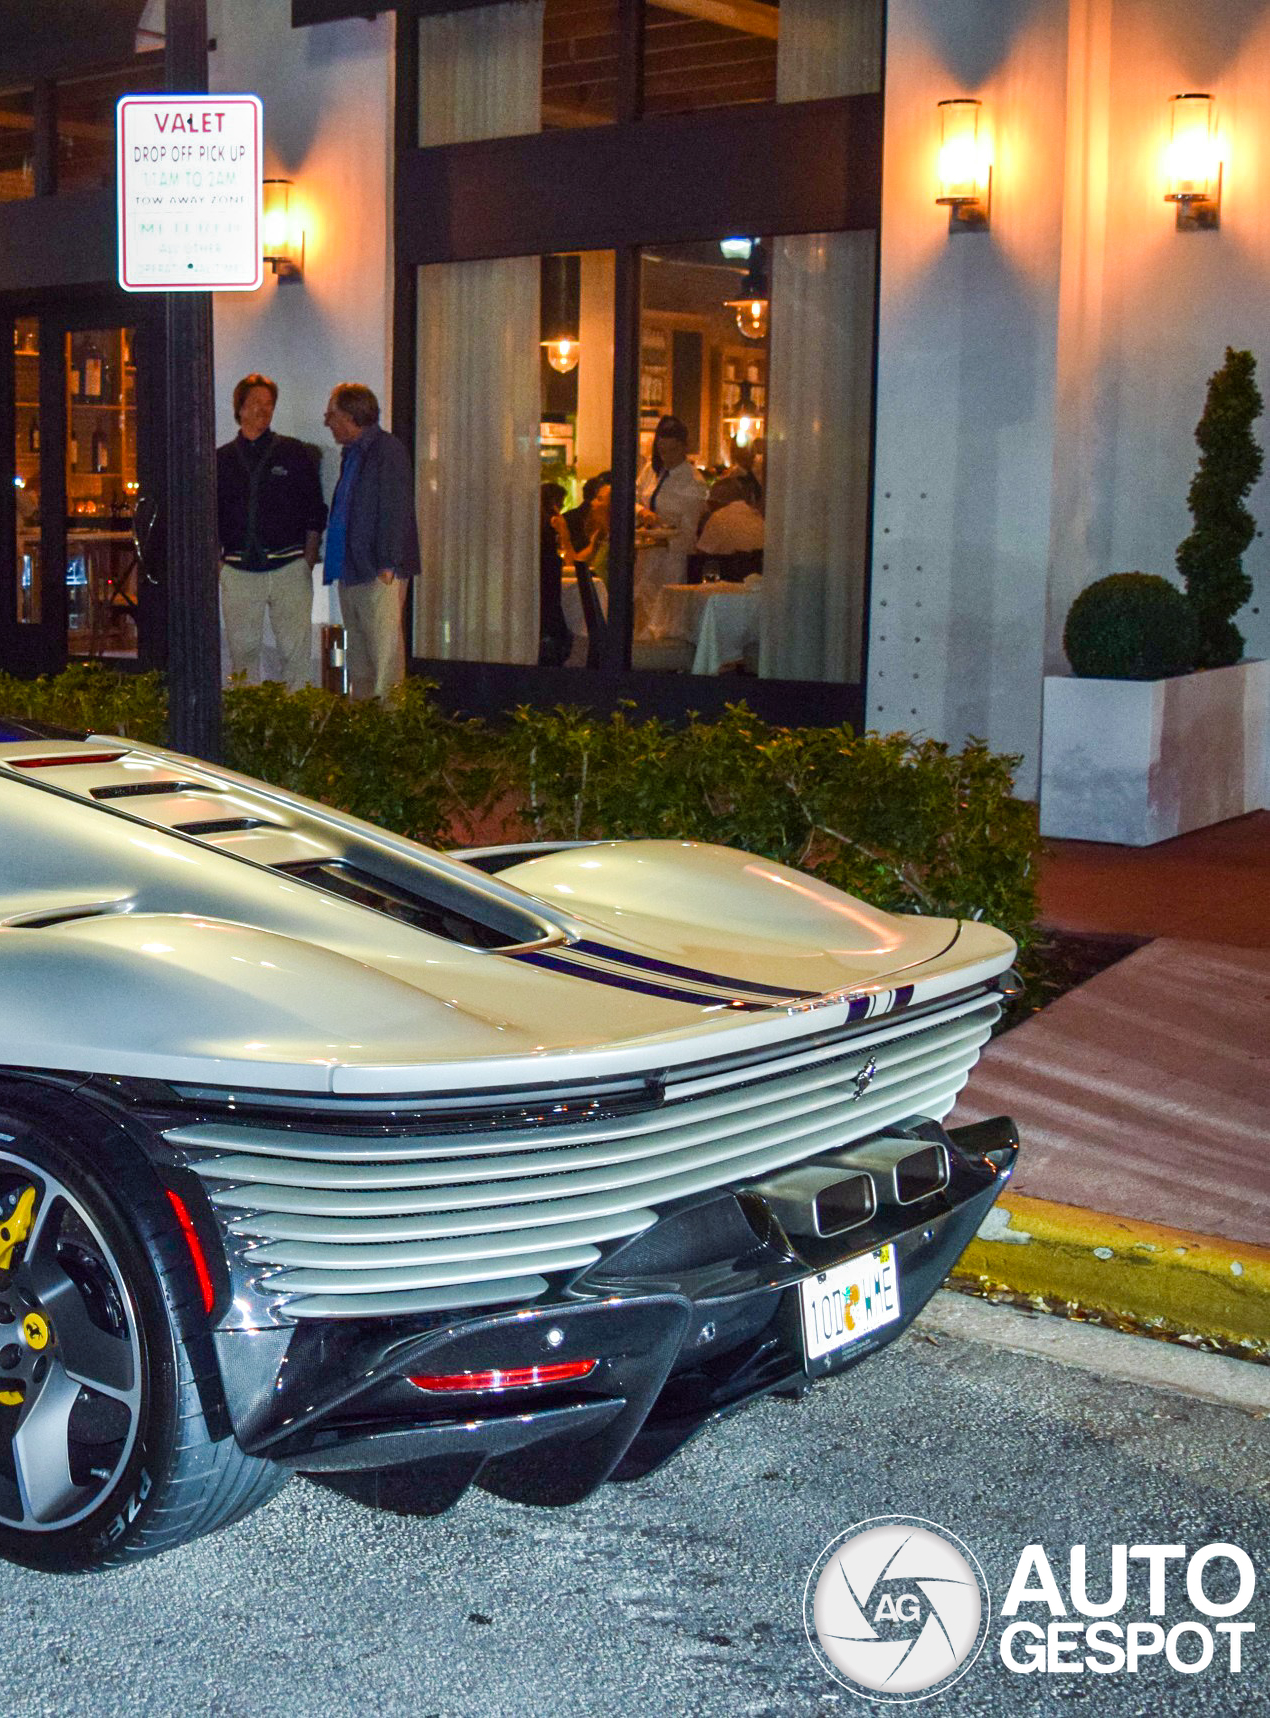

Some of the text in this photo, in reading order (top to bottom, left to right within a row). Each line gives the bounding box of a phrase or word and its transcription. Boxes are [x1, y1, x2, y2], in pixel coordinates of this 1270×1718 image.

[154, 112, 226, 133] VALET
[134, 145, 246, 162] DROP OFF PICK UP
[185, 171, 203, 188] TO
[135, 195, 163, 205] TOW
[169, 195, 205, 205] AWAY
